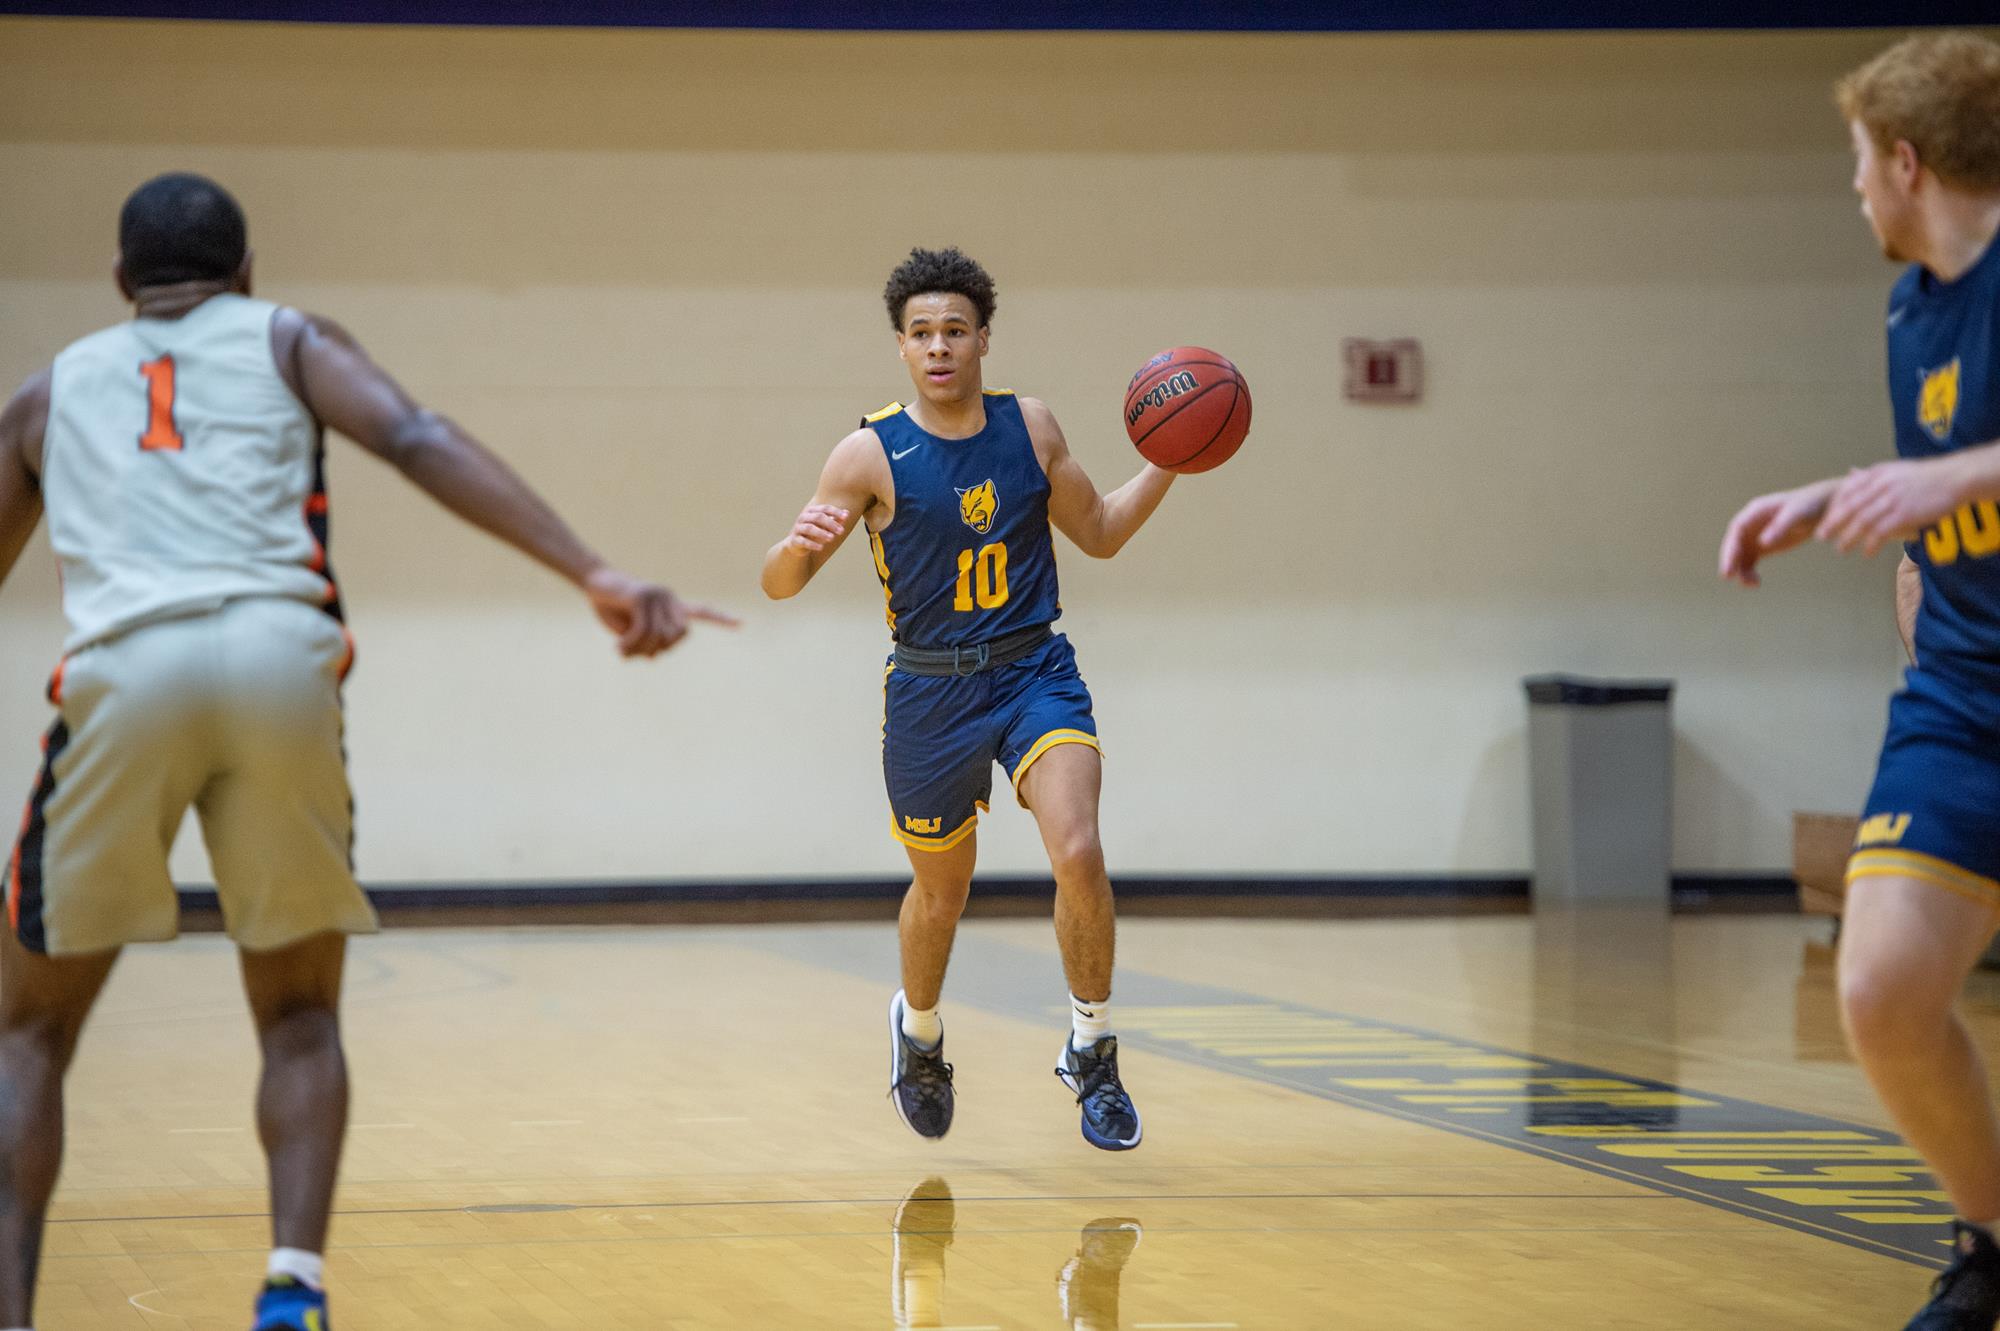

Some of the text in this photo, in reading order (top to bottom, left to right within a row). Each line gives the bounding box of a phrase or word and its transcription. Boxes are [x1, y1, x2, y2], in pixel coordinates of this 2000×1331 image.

[139, 351, 184, 451] 1
[1127, 368, 1200, 427] Wilson
[954, 541, 1010, 611] 10
[1523, 1124, 1957, 1246] JOSE
